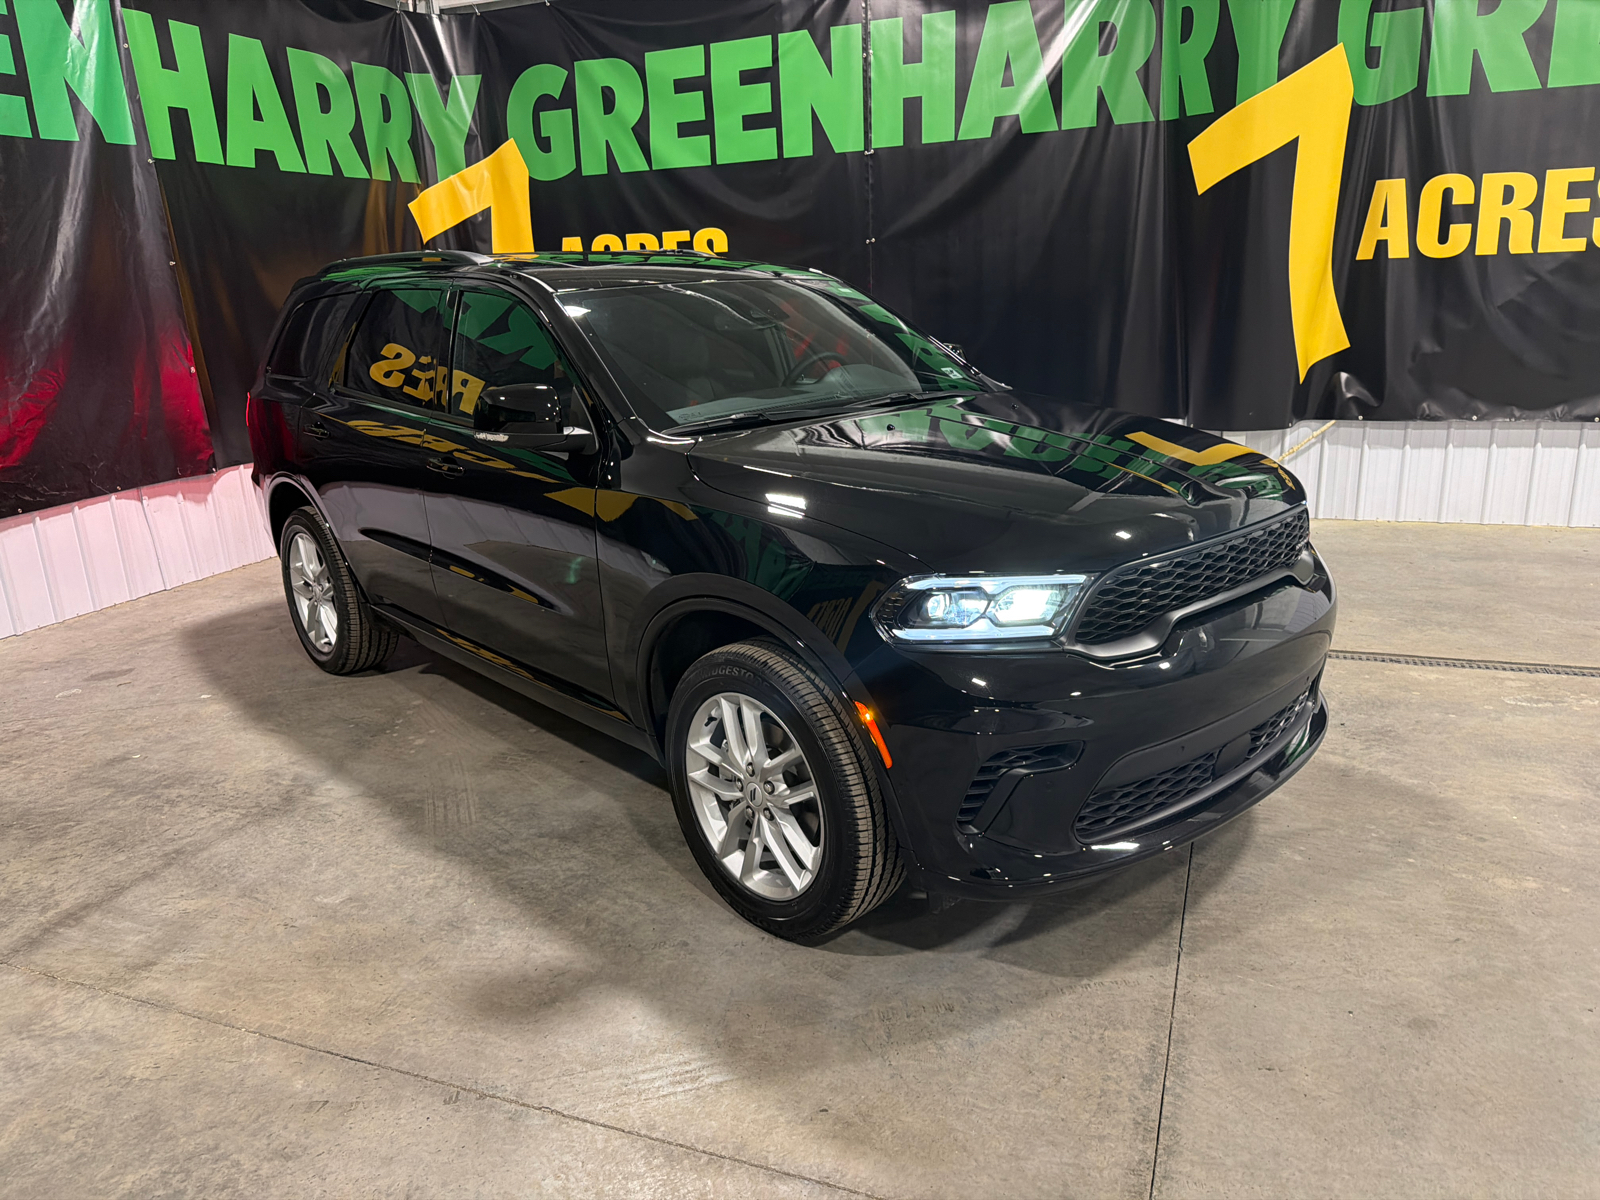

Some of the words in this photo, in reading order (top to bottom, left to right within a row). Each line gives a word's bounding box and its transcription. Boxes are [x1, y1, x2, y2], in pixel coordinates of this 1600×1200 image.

[122, 8, 482, 184] HARRY
[506, 23, 865, 182] GREEN
[870, 0, 1296, 149] HARRY
[1187, 42, 1355, 384] 7
[1355, 166, 1600, 260] ACRE
